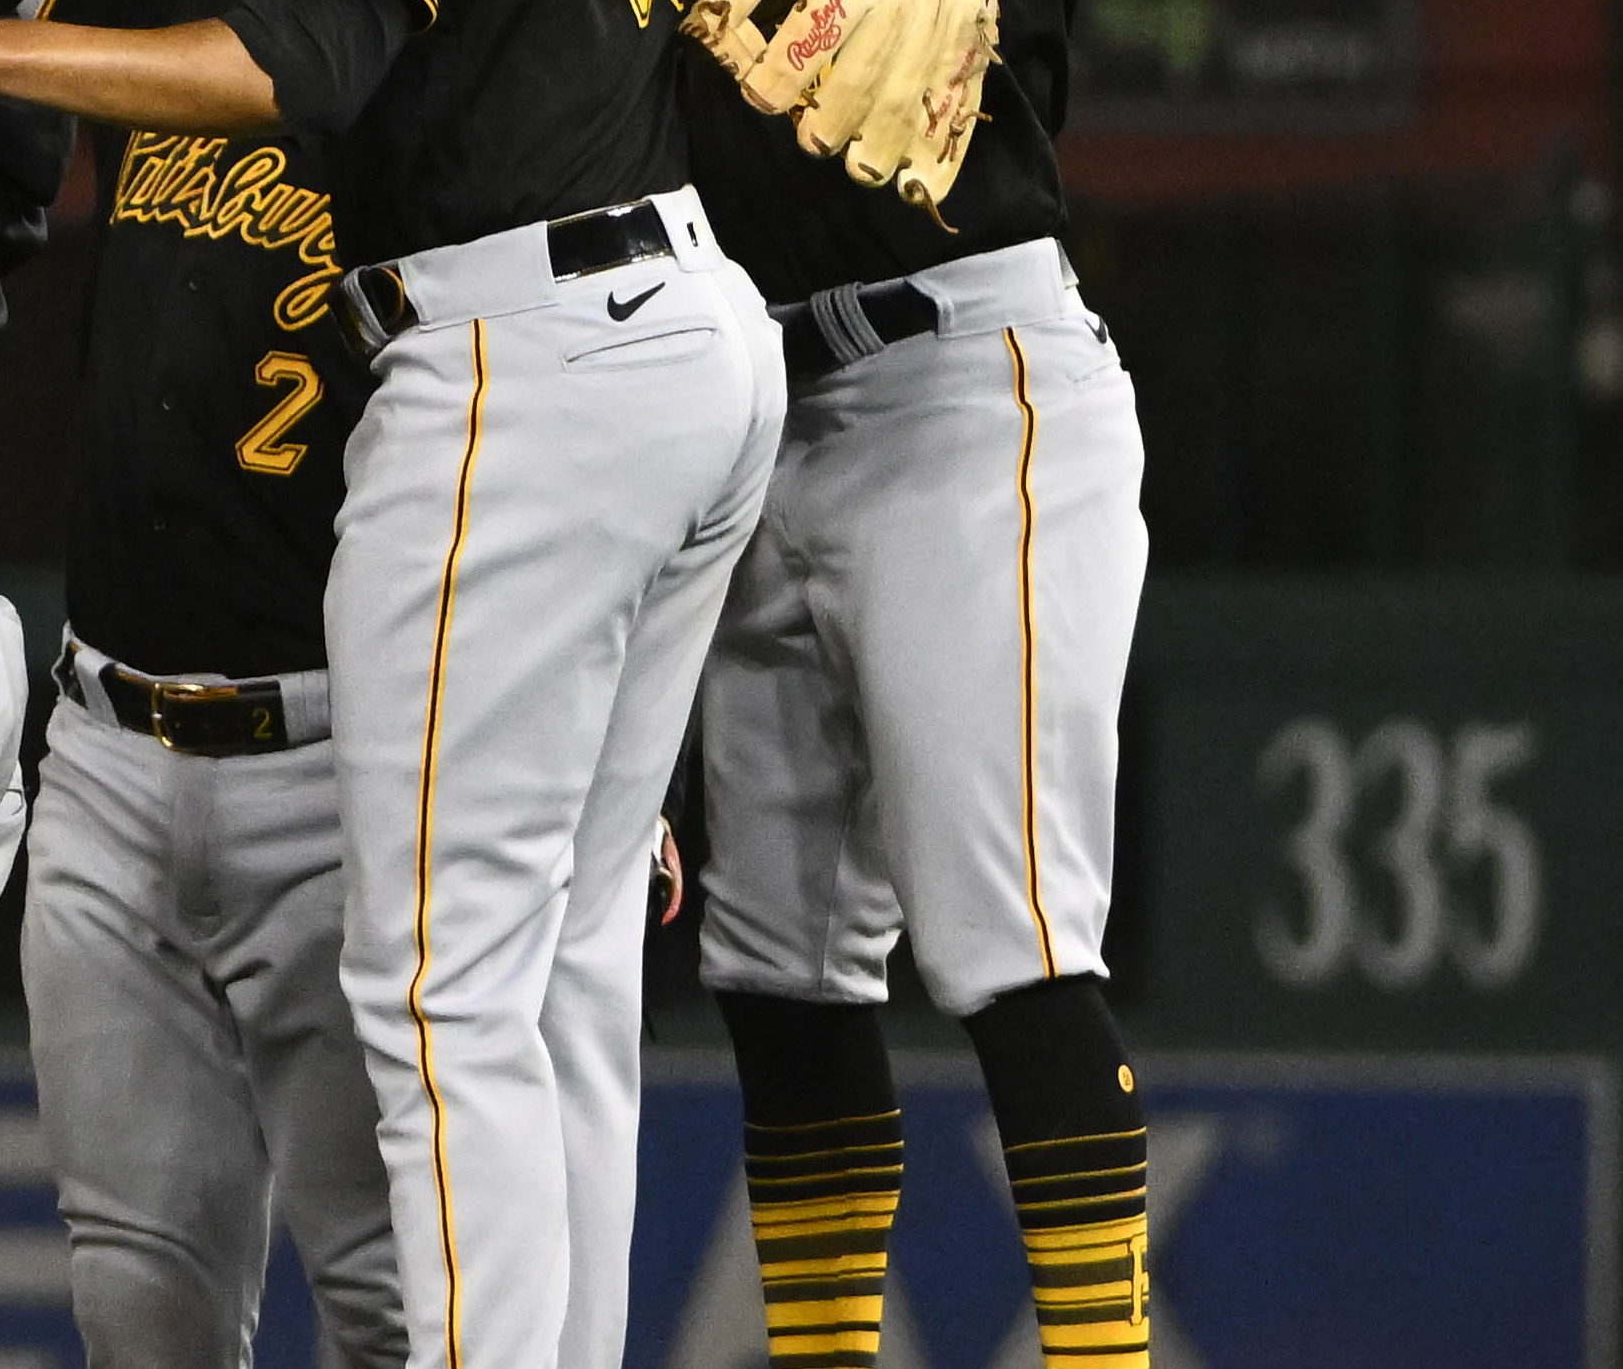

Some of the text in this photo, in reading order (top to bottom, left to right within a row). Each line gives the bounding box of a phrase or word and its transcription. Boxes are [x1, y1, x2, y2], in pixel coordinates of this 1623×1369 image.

[234, 350, 324, 476] 2
[252, 706, 273, 739] 2
[1254, 715, 1544, 990] 335
